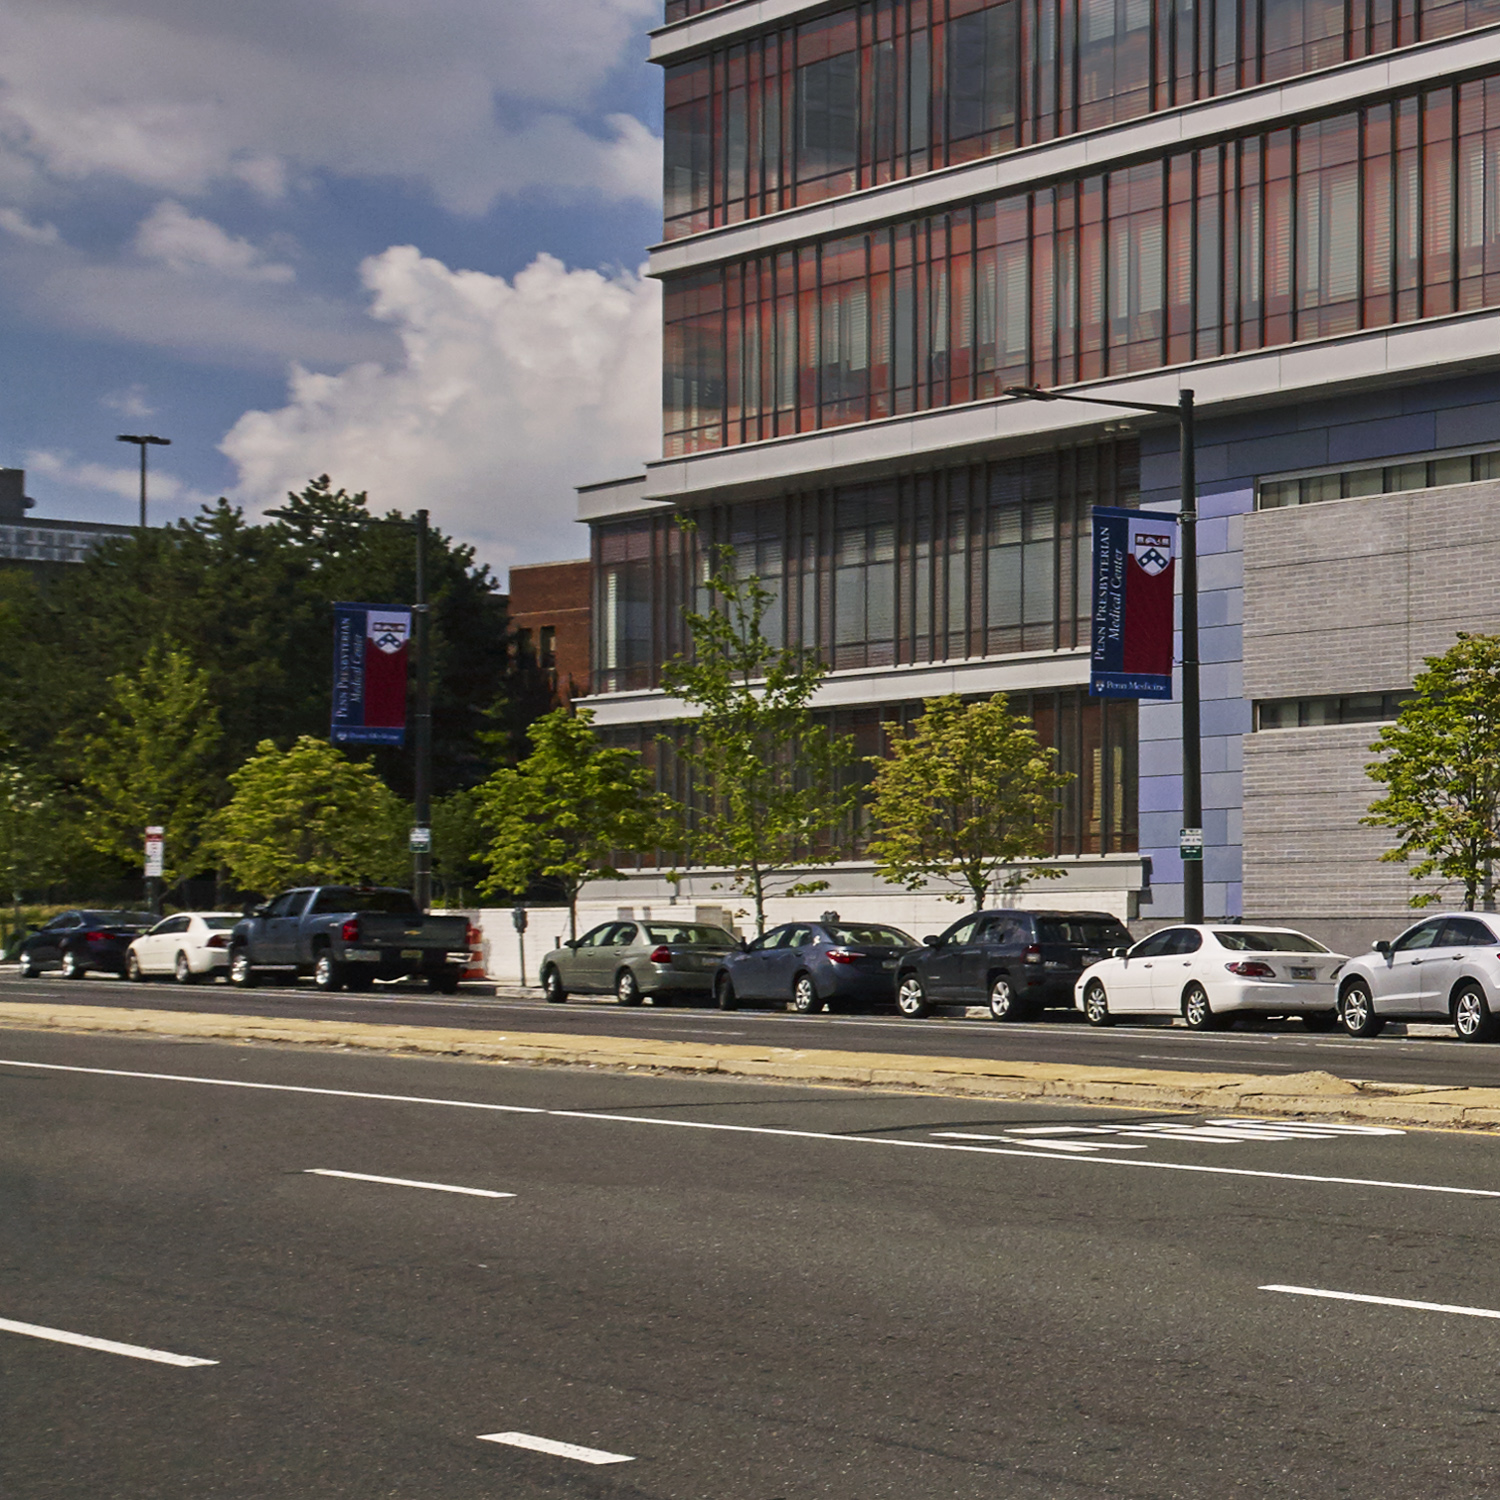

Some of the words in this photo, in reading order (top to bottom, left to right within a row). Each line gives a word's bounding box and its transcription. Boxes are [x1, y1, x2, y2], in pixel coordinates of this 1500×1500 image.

[1096, 526, 1110, 621] PRESBYTERIAN
[1110, 549, 1123, 589] Center
[1108, 592, 1122, 640] Medical
